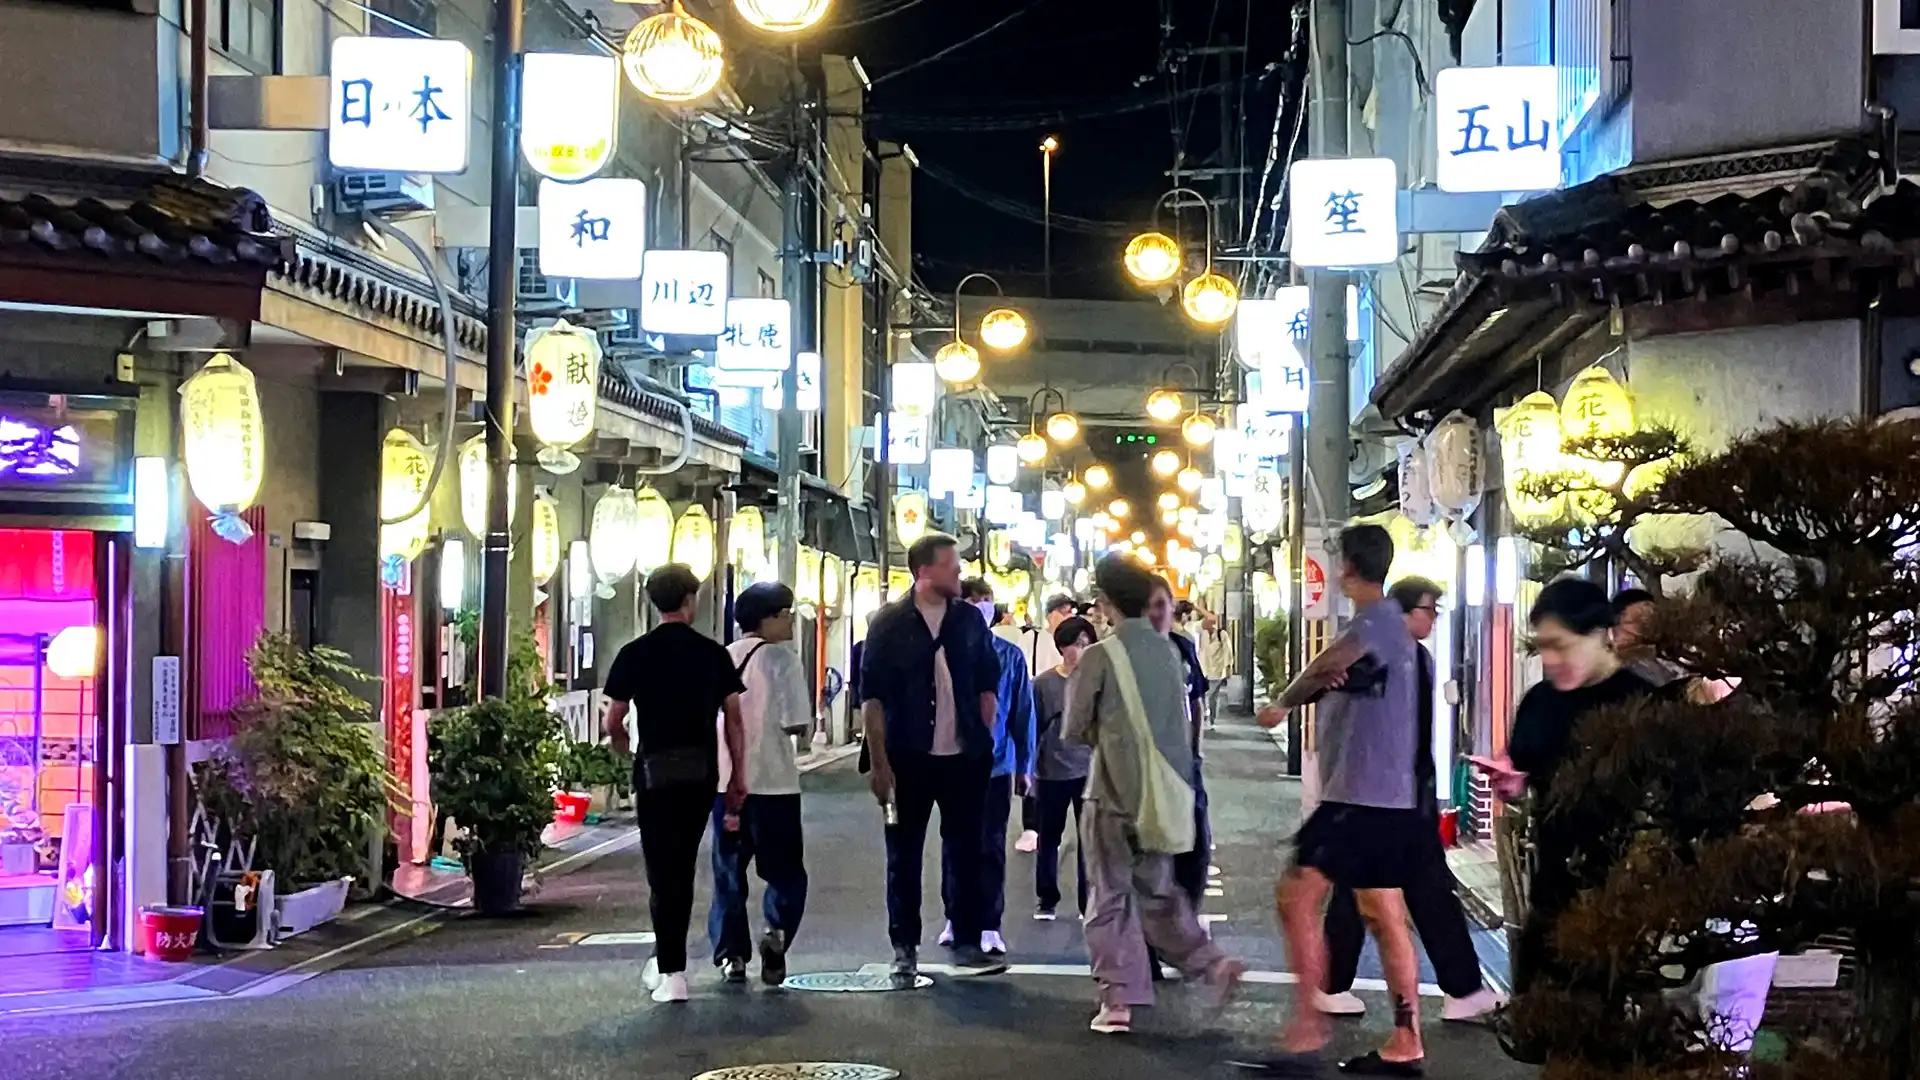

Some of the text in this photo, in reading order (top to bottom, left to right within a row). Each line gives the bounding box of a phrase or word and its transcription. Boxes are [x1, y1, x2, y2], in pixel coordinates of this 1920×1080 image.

[341, 75, 453, 134] 日本
[1449, 99, 1550, 157] 五山
[569, 209, 611, 249] 和
[652, 278, 715, 307] 川辺
